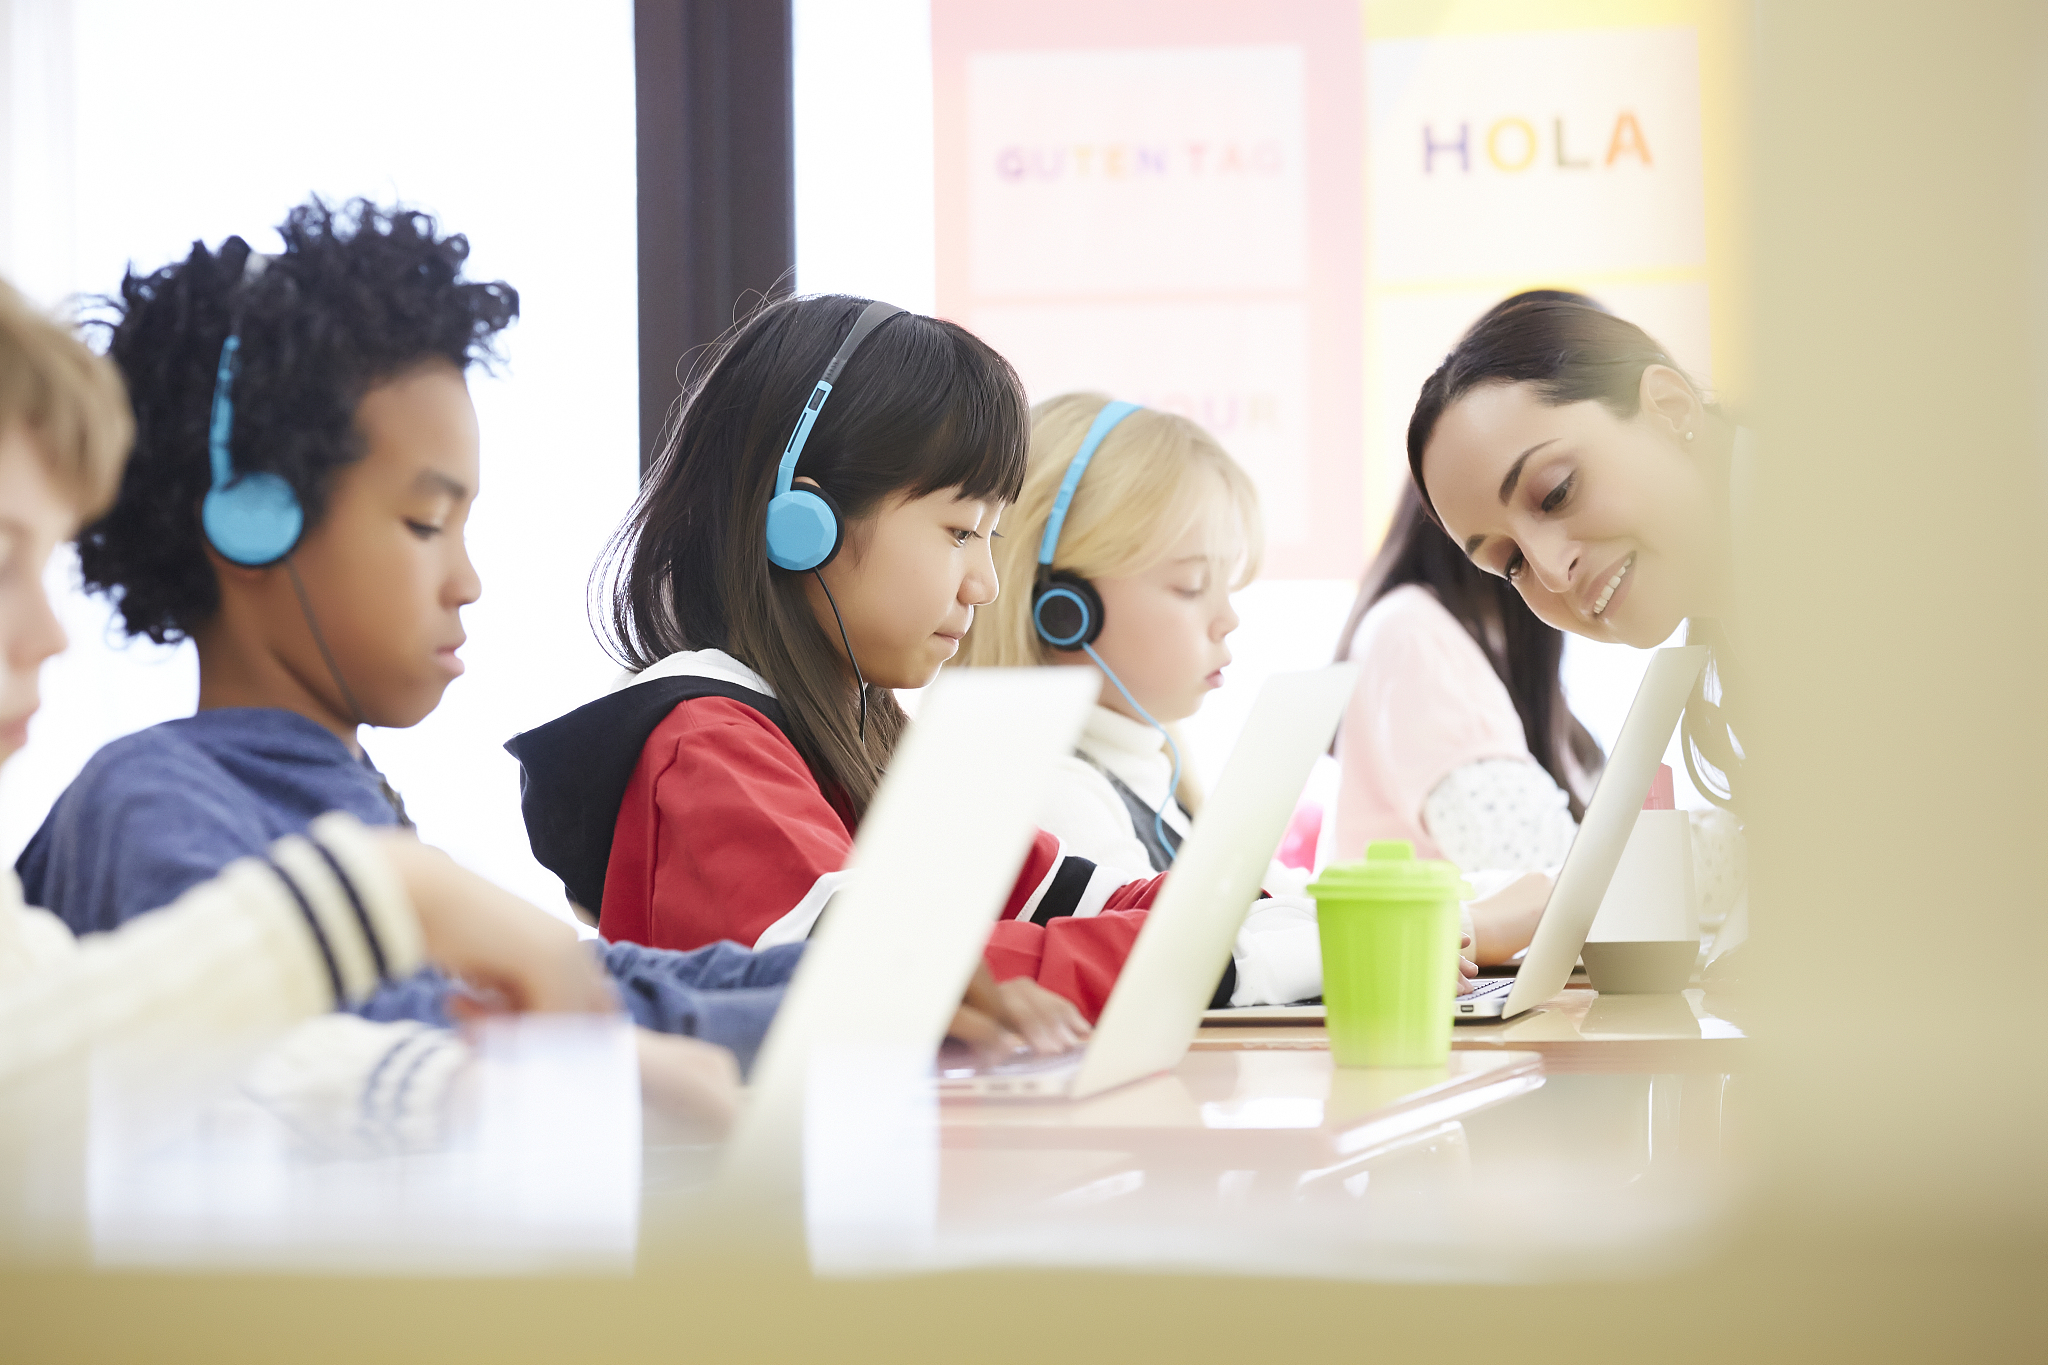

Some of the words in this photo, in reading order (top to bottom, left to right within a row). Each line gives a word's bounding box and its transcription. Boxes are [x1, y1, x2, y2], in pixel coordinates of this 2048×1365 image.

[995, 143, 1168, 183] GUTEN
[1186, 139, 1285, 178] TAG
[1421, 109, 1655, 174] HOLA
